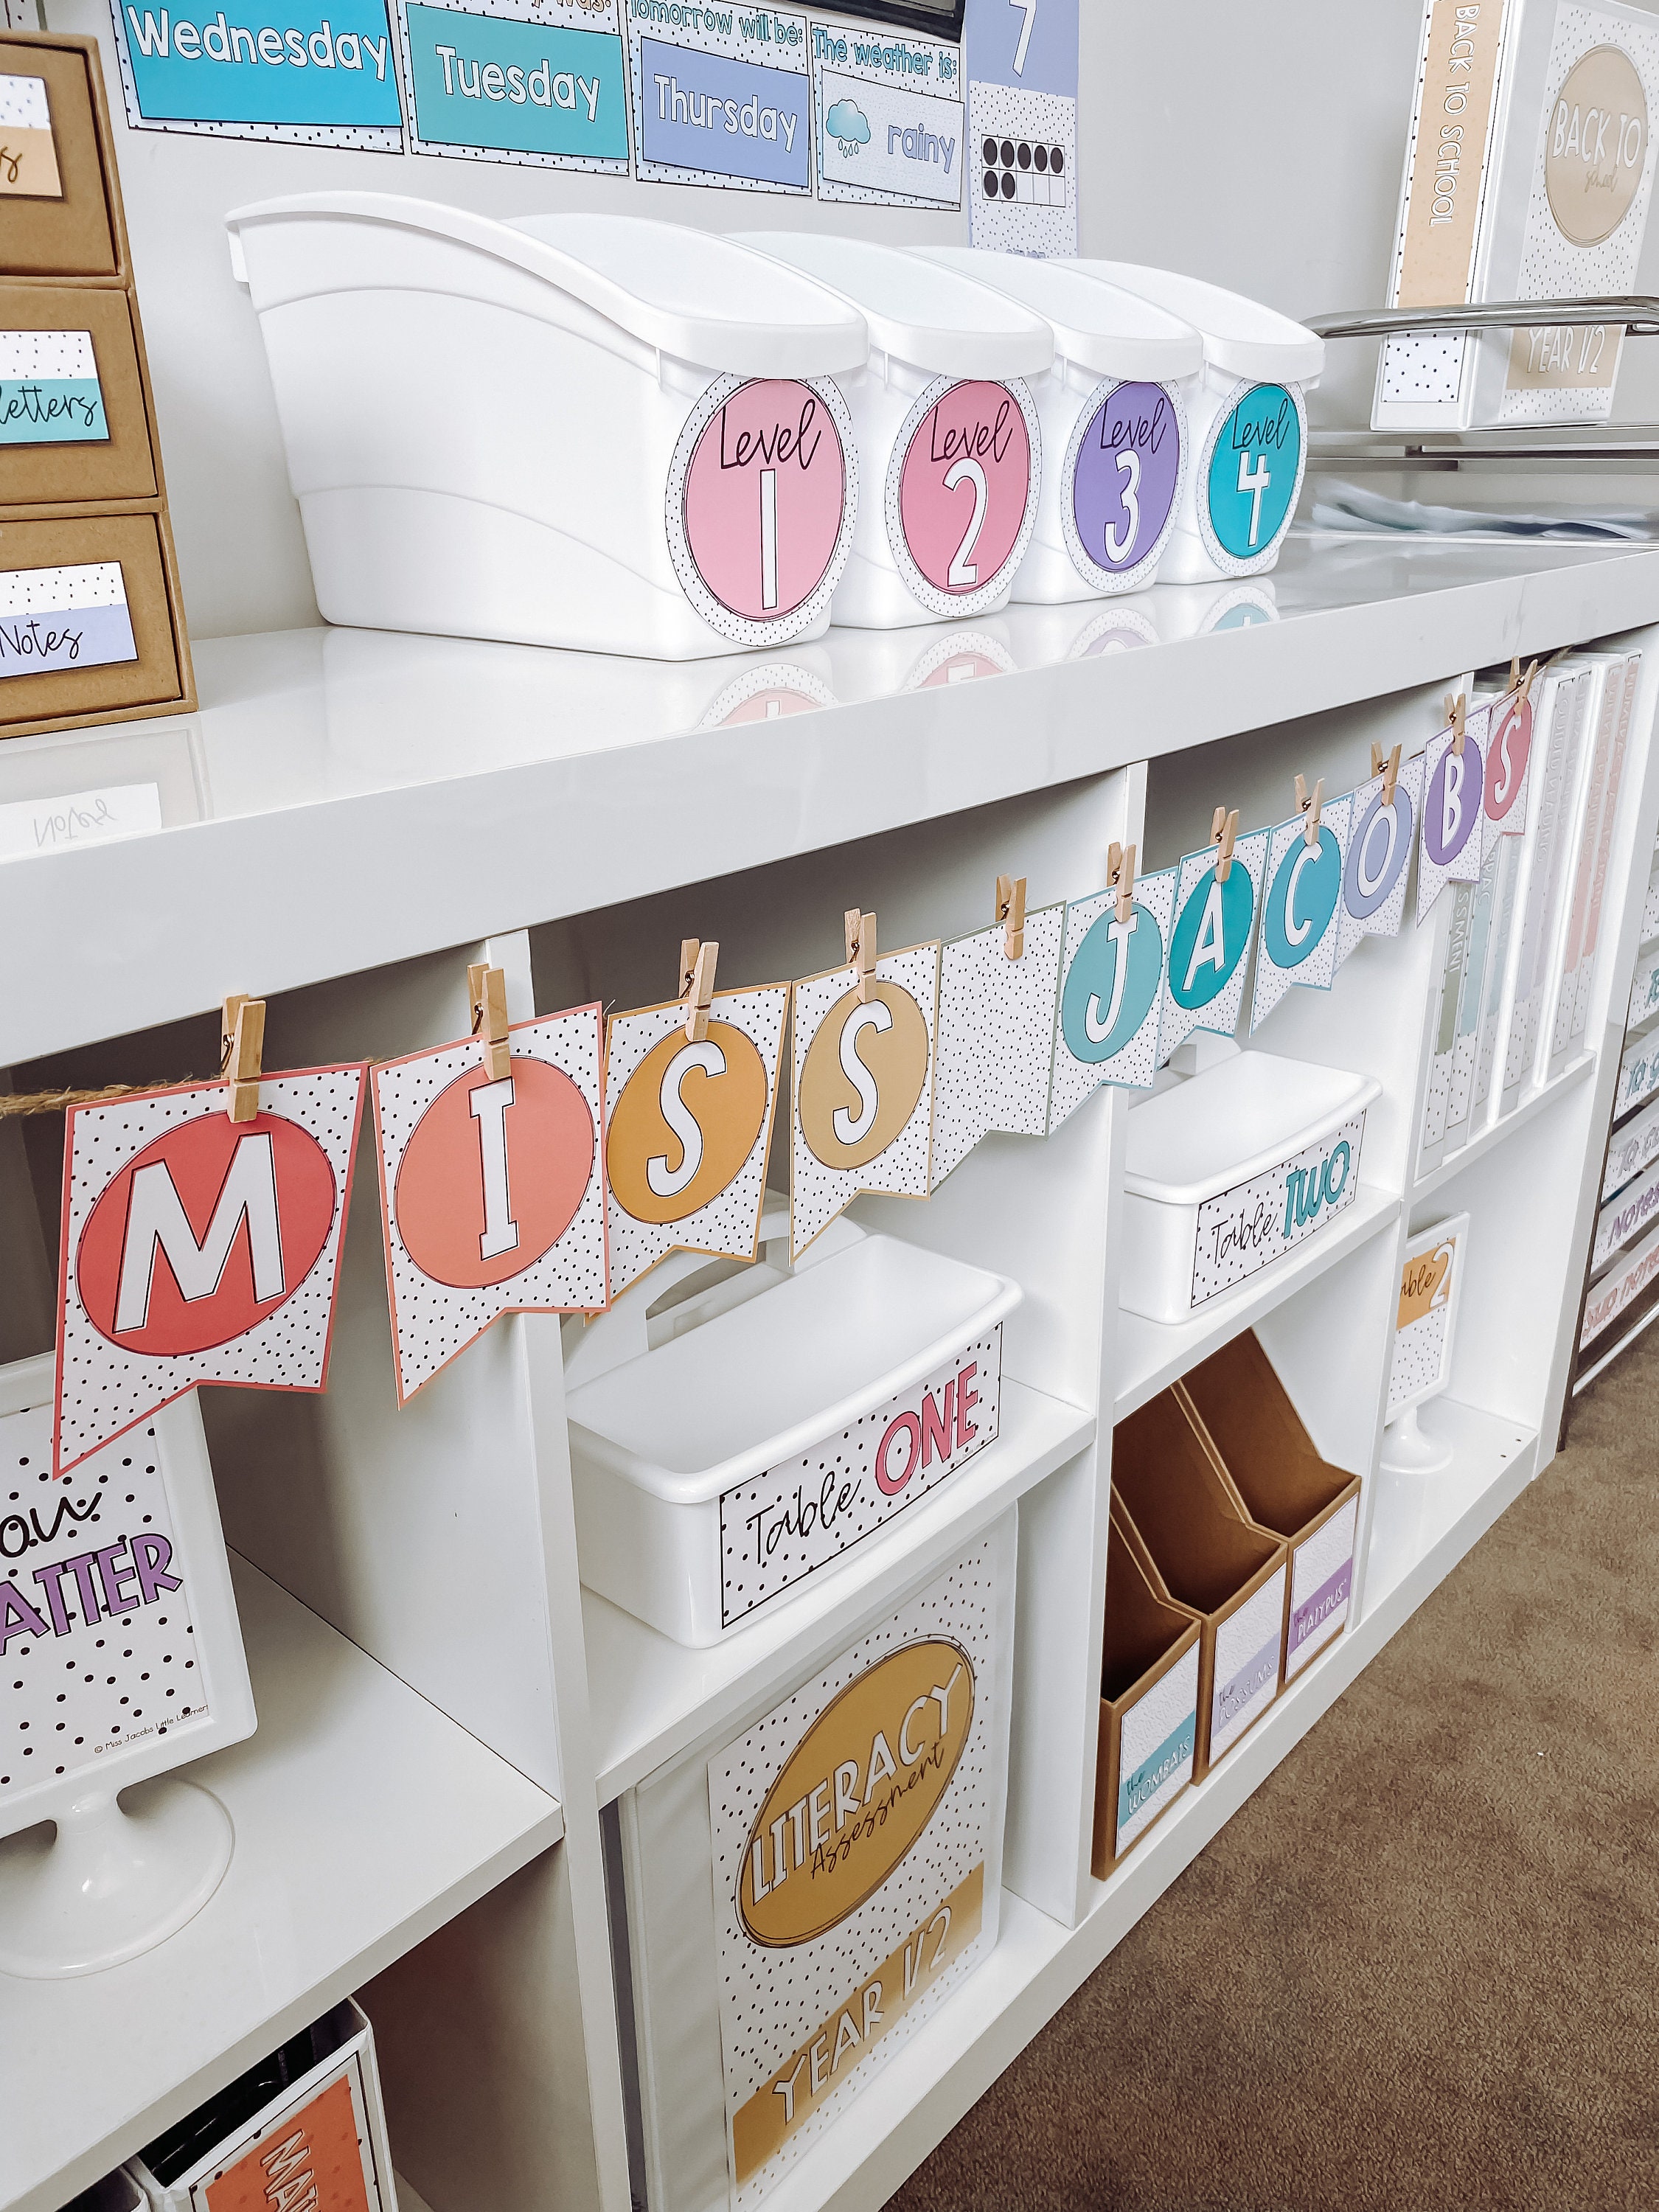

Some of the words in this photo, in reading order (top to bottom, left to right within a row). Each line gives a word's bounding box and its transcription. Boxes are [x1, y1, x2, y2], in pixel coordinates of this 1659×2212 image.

[127, 4, 387, 81] Wednesday
[739, 13, 771, 41] will
[774, 17, 804, 46] be:
[813, 28, 847, 62] The
[854, 43, 933, 76] weather
[939, 51, 957, 79] is:
[1009, 0, 1037, 77] 7
[1448, 3, 1481, 74] BACK
[435, 44, 599, 122] Tuesday
[654, 74, 798, 153] Thursday
[1443, 81, 1470, 114] TO
[888, 122, 956, 174] rainy
[1552, 98, 1611, 166] BACK
[1615, 113, 1642, 169] TO
[1429, 125, 1464, 226] SCHOOL
[1526, 326, 1575, 374] YEAR
[720, 399, 821, 469] Level
[930, 398, 1012, 462] Level
[1099, 397, 1166, 451] Level
[1232, 398, 1290, 449] Level
[942, 458, 989, 586] 2
[1104, 450, 1141, 563] 3
[1237, 451, 1270, 548] 4
[759, 469, 779, 611] 1
[0, 619, 83, 659] Notes
[1449, 890, 1469, 973] SSMENT
[1211, 1200, 1278, 1265] Table
[1284, 1141, 1349, 1239] TWO
[1429, 1242, 1455, 1310] 2
[745, 1471, 861, 1565] Table
[875, 1361, 978, 1496] ONE
[0, 1492, 102, 1558] ou
[0, 1533, 184, 1655] ATTER
[105, 1739, 122, 1750] Miss
[125, 1727, 154, 1742] Jacobs
[751, 1663, 963, 1907] LITERACY
[810, 1742, 945, 1879] Assessment
[772, 1980, 884, 2126] YEAR
[260, 2128, 319, 2212] MAT
